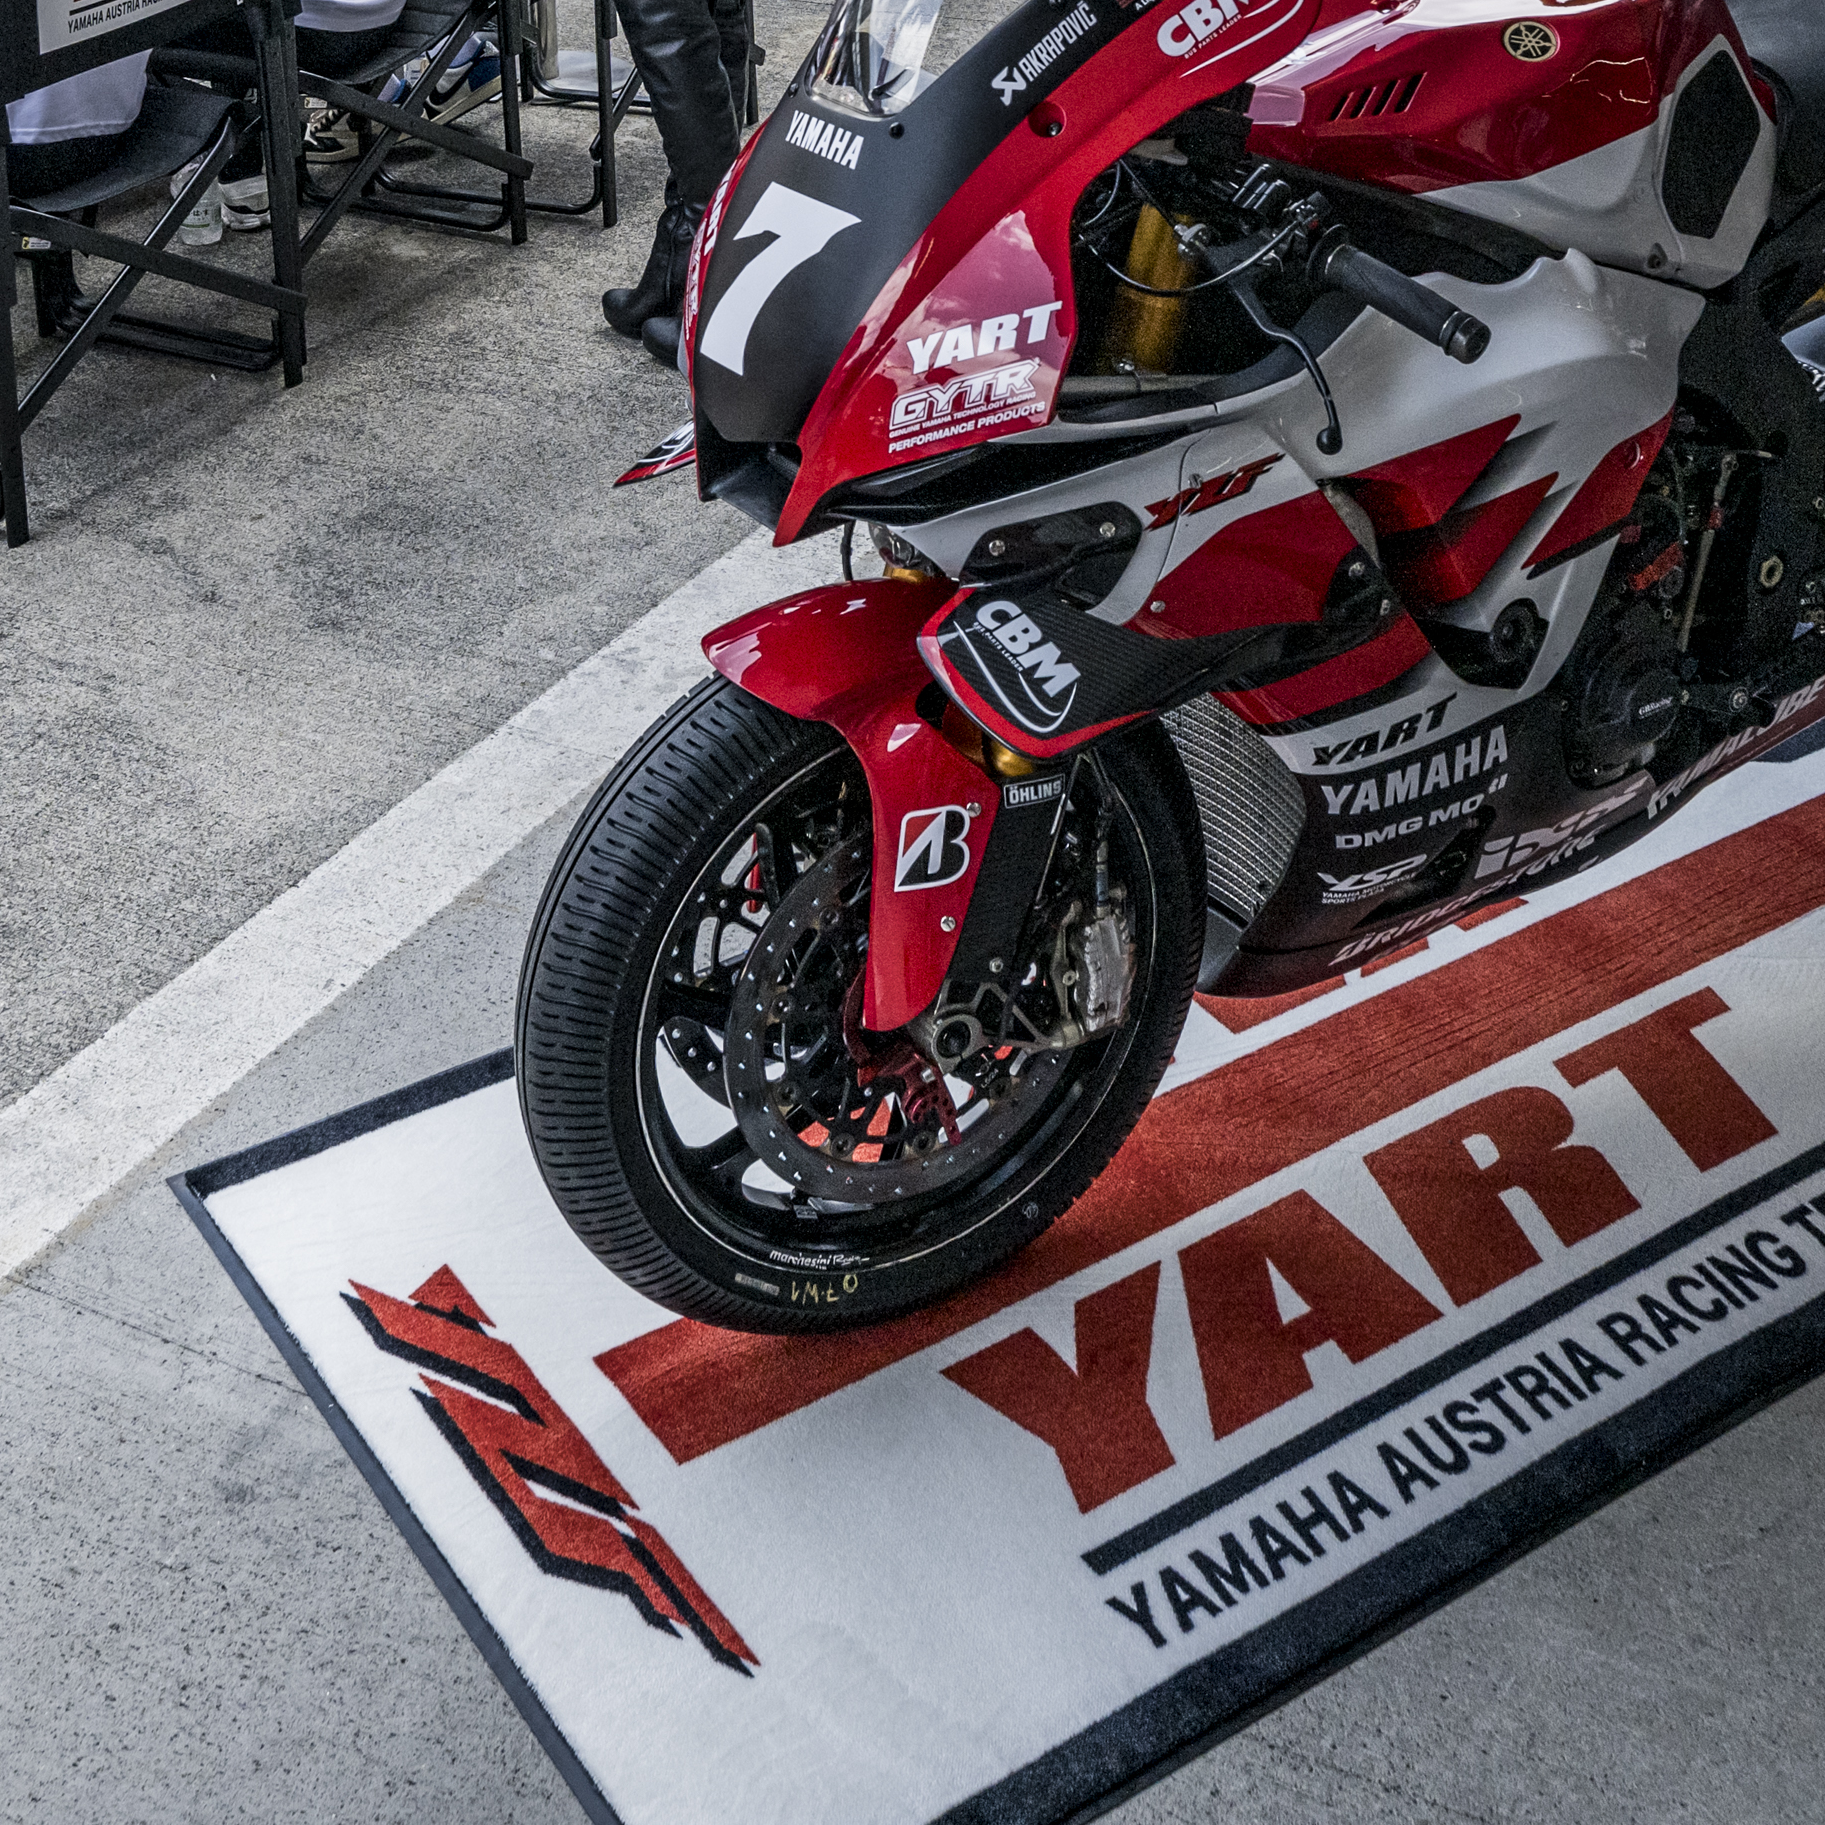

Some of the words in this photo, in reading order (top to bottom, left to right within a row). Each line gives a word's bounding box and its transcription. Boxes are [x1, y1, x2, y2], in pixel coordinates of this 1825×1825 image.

[68, 12, 104, 34] YAMAHA
[105, 0, 140, 24] AUSTRIA
[1018, 0, 1098, 81] AKRAPOVIČ
[1197, 32, 1218, 50] PARTS
[1216, 14, 1242, 37] LEADER
[785, 109, 864, 170] YAMAHA
[700, 180, 863, 376] 7
[908, 301, 1062, 374] YART
[888, 358, 1041, 430] GYTR
[888, 421, 921, 439] GENUINE
[921, 414, 950, 431] YAMAHA
[950, 402, 1004, 424] TECHNOLOGY
[1005, 391, 1037, 409] RACING
[888, 420, 975, 454] PERFORMANCE
[977, 401, 1046, 431] PRODUCTS
[976, 599, 1082, 698] CBM
[985, 631, 1002, 651] PARTS
[1001, 649, 1024, 672] LEADER
[1310, 693, 1458, 768] YART
[1008, 778, 1062, 805] ÖHLINS
[1321, 724, 1509, 816] YAMAHA
[1335, 817, 1423, 849] DMG
[1317, 853, 1428, 892] YSP
[1321, 889, 1361, 899] YAMAHA
[945, 987, 1783, 1515] YART
[1107, 1470, 1391, 1649] YAMAHA
[1375, 1338, 1627, 1505] AUSTRIA
[1596, 1228, 1811, 1368] RACING
